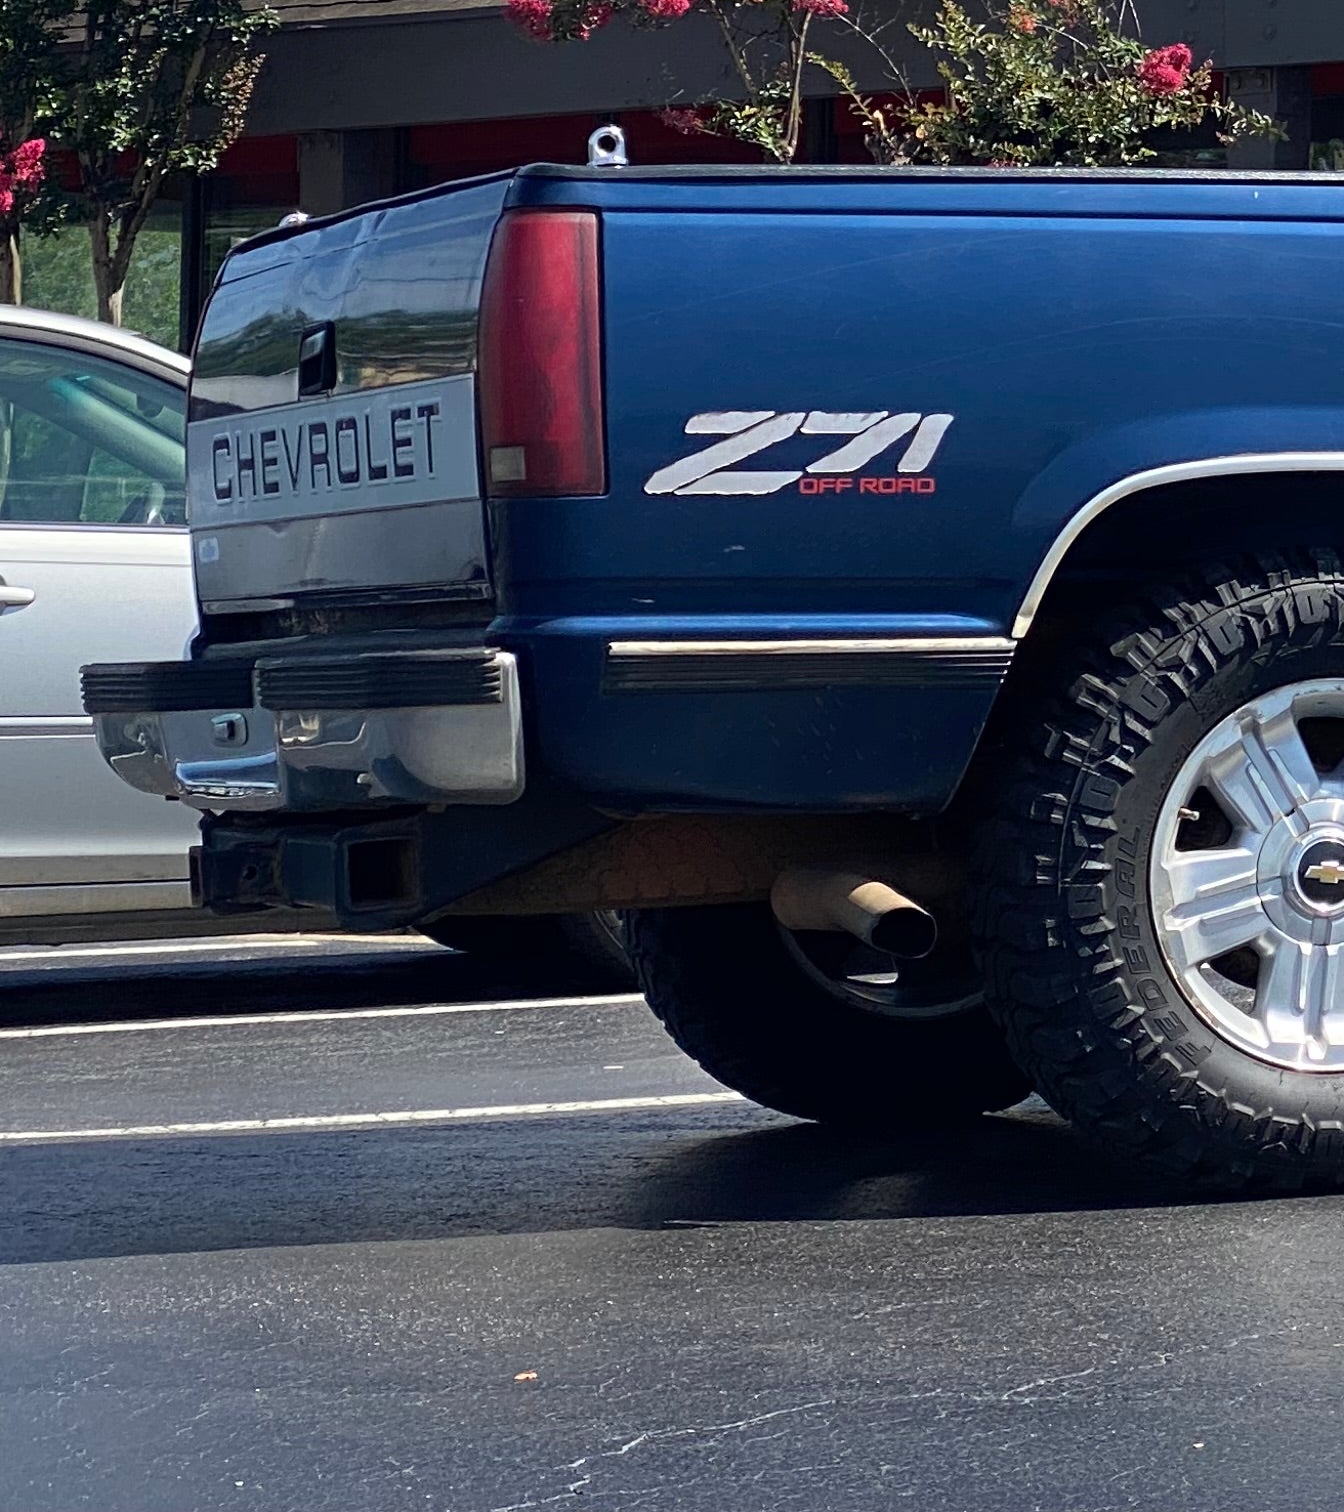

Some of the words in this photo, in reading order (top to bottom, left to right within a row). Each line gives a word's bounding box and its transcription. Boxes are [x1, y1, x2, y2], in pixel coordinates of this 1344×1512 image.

[211, 397, 441, 504] CHEVROLET
[643, 410, 954, 496] Z71
[799, 477, 853, 494] OFF
[859, 477, 936, 494] ROAD
[1114, 826, 1212, 1066] FEDERAL
